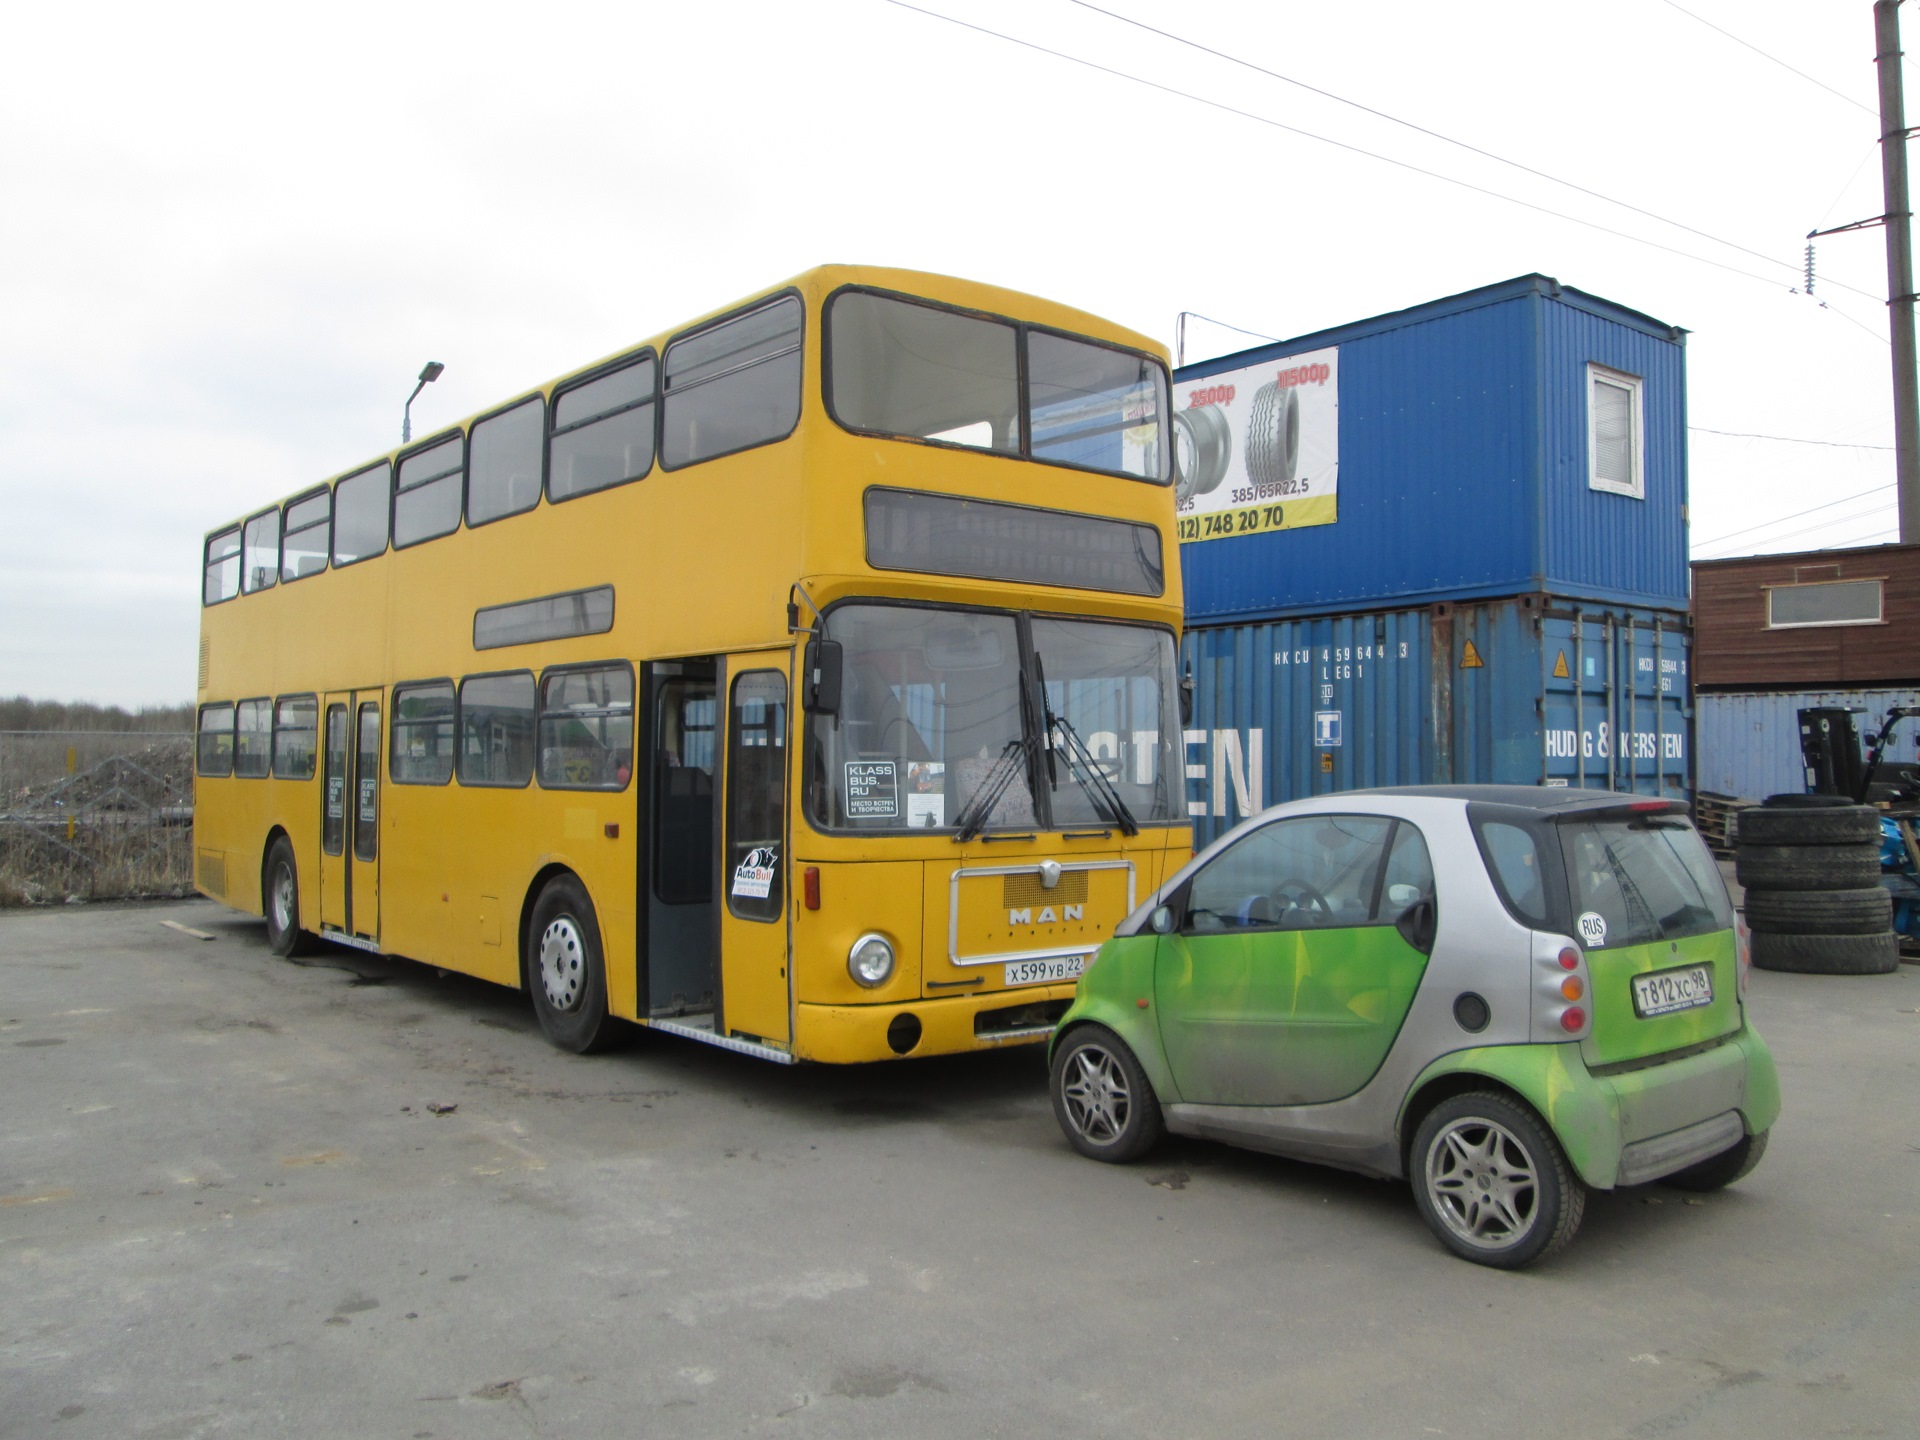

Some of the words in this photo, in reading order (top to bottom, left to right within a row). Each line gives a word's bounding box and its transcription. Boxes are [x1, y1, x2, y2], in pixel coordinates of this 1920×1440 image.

[1189, 384, 1236, 409] 2500р
[1231, 478, 1309, 503] 385/65R22,5
[1204, 513, 1233, 536] 748
[1238, 509, 1259, 532] 20
[1264, 505, 1284, 527] 70
[1274, 650, 1309, 665] HKCU
[1545, 729, 1593, 758] HUDG
[849, 766, 892, 776] KLASS
[850, 776, 880, 786] BUS.
[850, 786, 869, 796] RU
[737, 867, 772, 881] AutoBull
[1009, 904, 1083, 925] MAN
[1583, 918, 1603, 935] RUS
[1068, 957, 1081, 971] 22
[1692, 971, 1706, 989] 98
